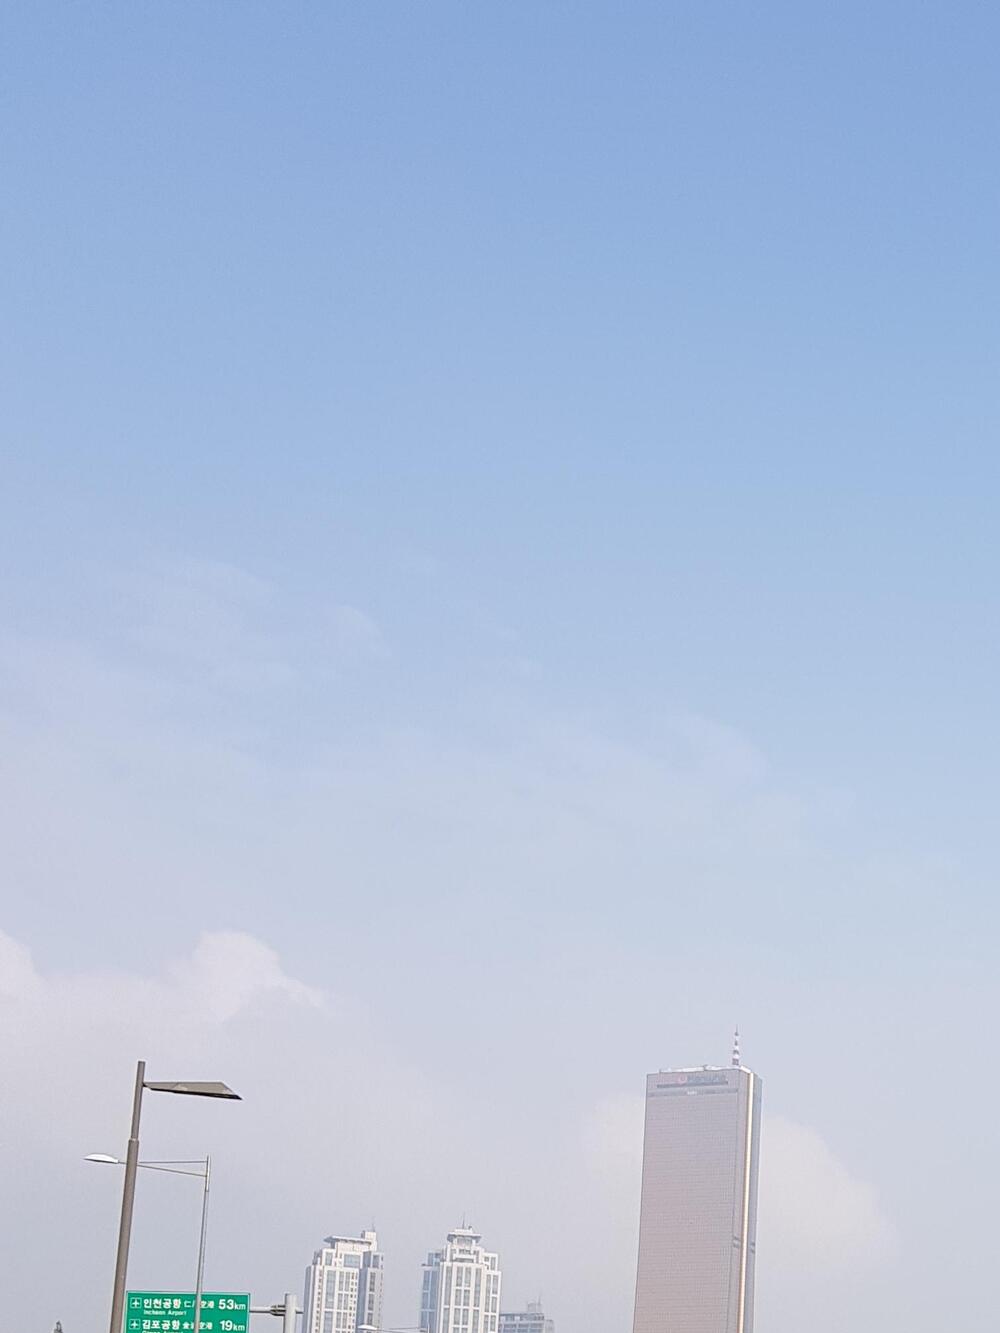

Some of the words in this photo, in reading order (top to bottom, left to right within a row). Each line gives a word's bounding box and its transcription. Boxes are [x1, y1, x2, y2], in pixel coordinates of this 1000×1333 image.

[144, 1298, 181, 1309] 인천공항
[218, 1299, 246, 1310] 53km
[142, 1320, 180, 1330] 김포공항
[219, 1320, 245, 1331] 19km
